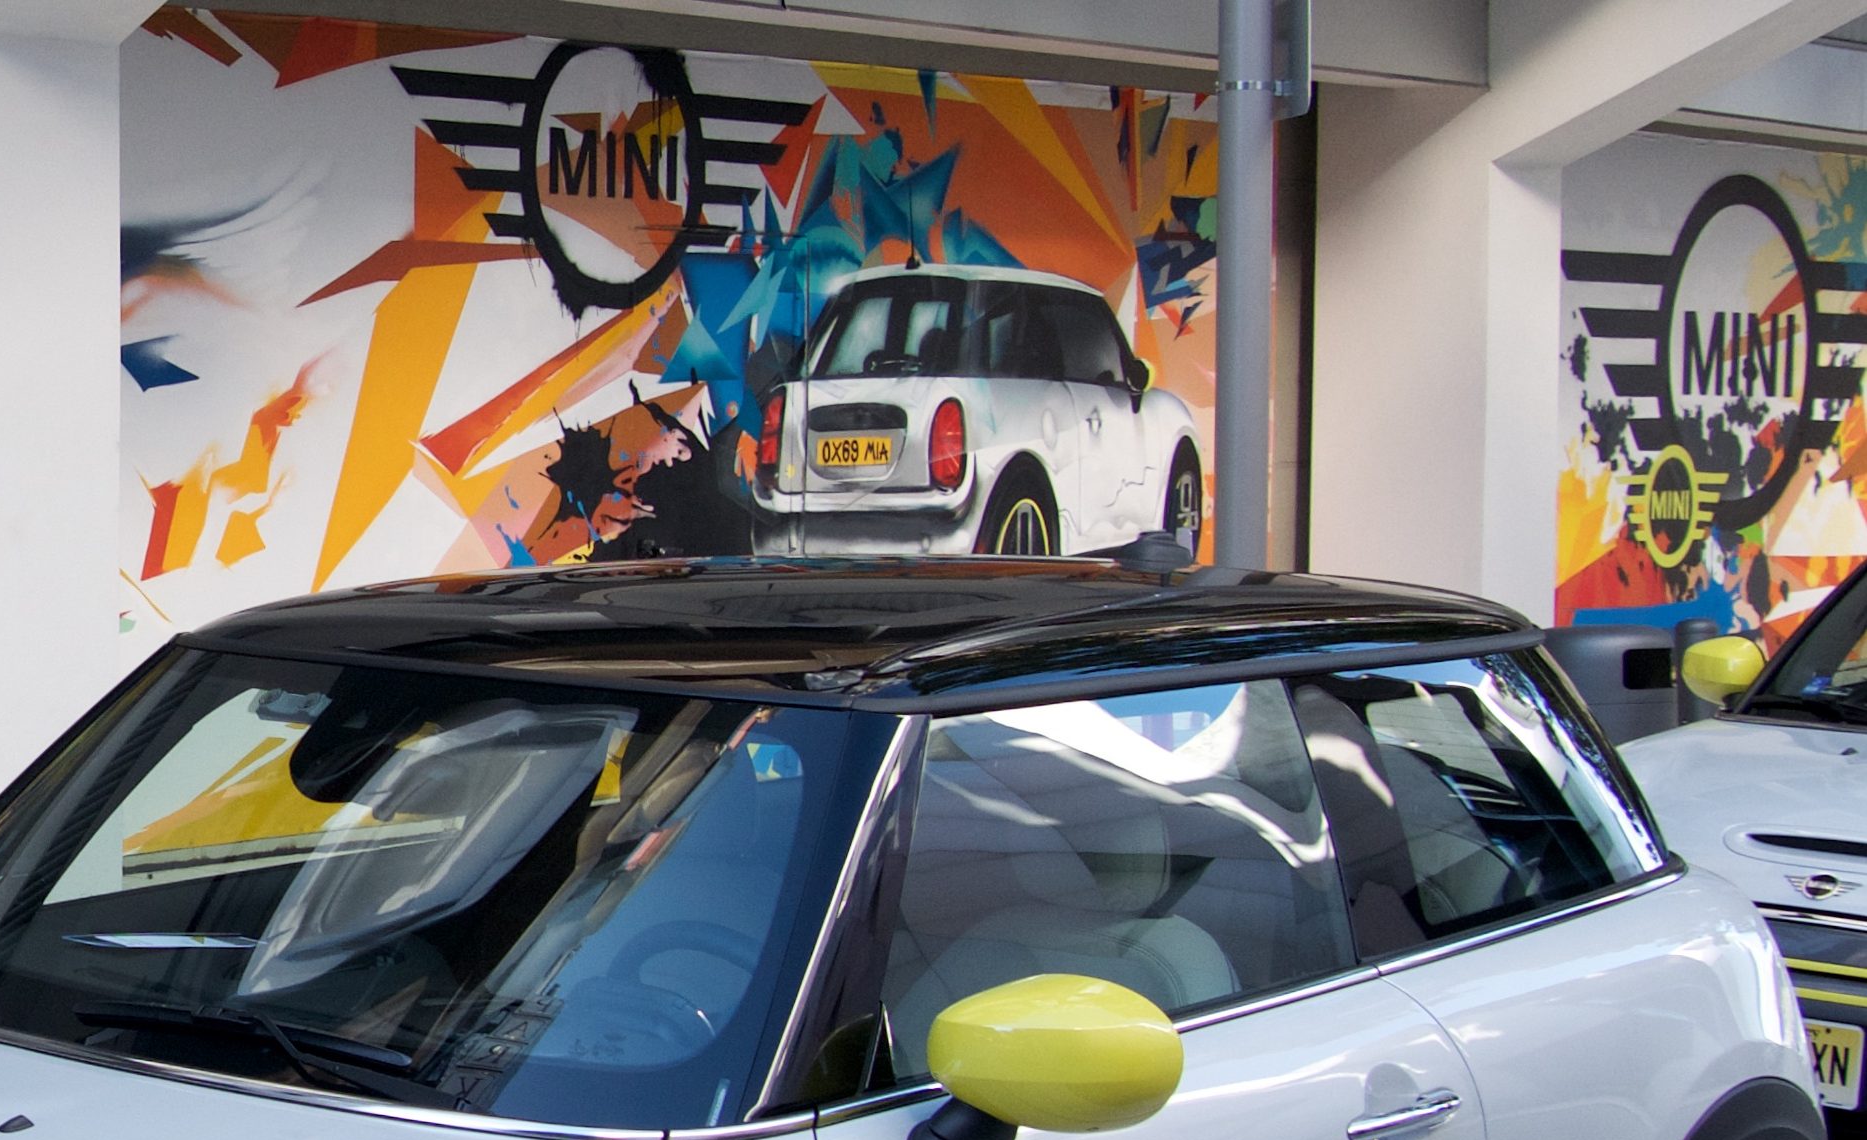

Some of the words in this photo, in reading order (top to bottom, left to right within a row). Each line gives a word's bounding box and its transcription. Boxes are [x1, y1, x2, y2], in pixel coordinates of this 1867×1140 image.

[548, 126, 678, 201] MINI
[1681, 310, 1795, 398] MINI
[863, 441, 889, 461] MIA
[1650, 489, 1691, 521] MINI
